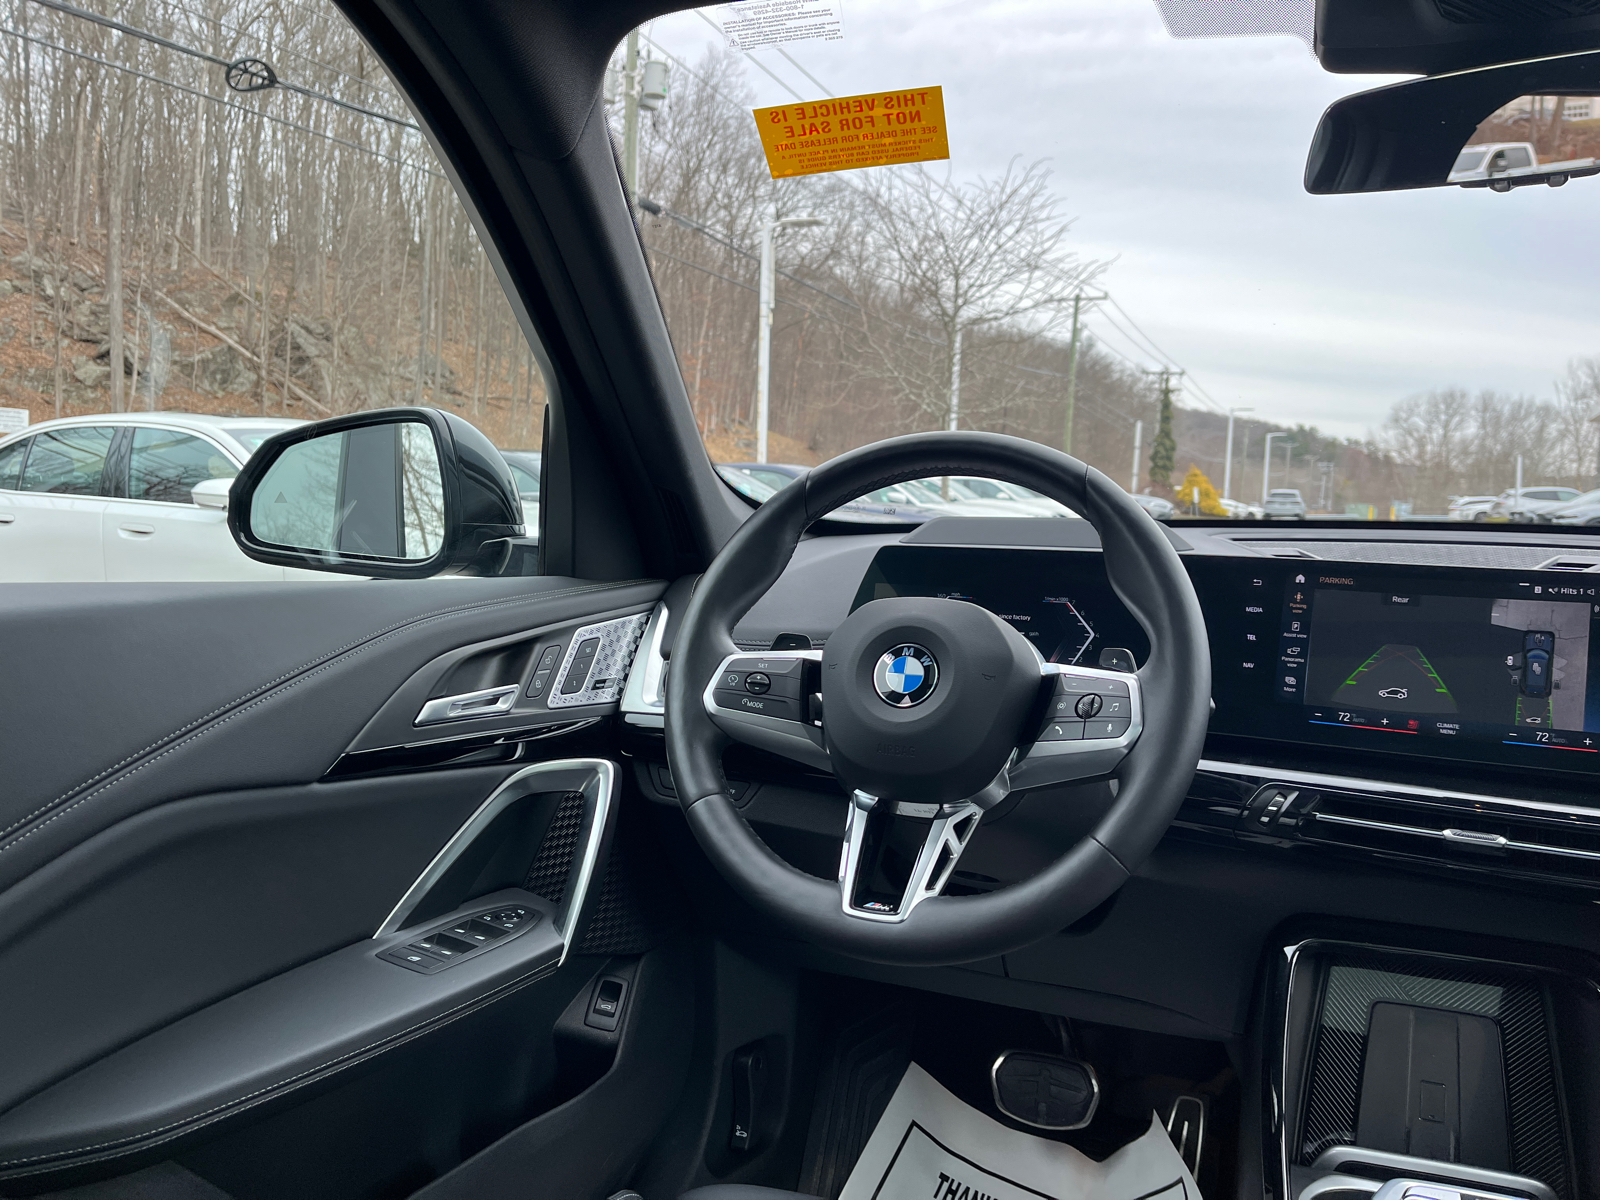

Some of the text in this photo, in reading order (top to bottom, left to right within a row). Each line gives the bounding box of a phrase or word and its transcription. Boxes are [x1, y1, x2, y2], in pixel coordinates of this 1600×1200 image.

[1319, 576, 1354, 585] PARKING
[884, 647, 932, 667] BMW
[1338, 711, 1351, 722] 72
[1536, 732, 1549, 742] 72
[933, 1172, 998, 1200] THA
